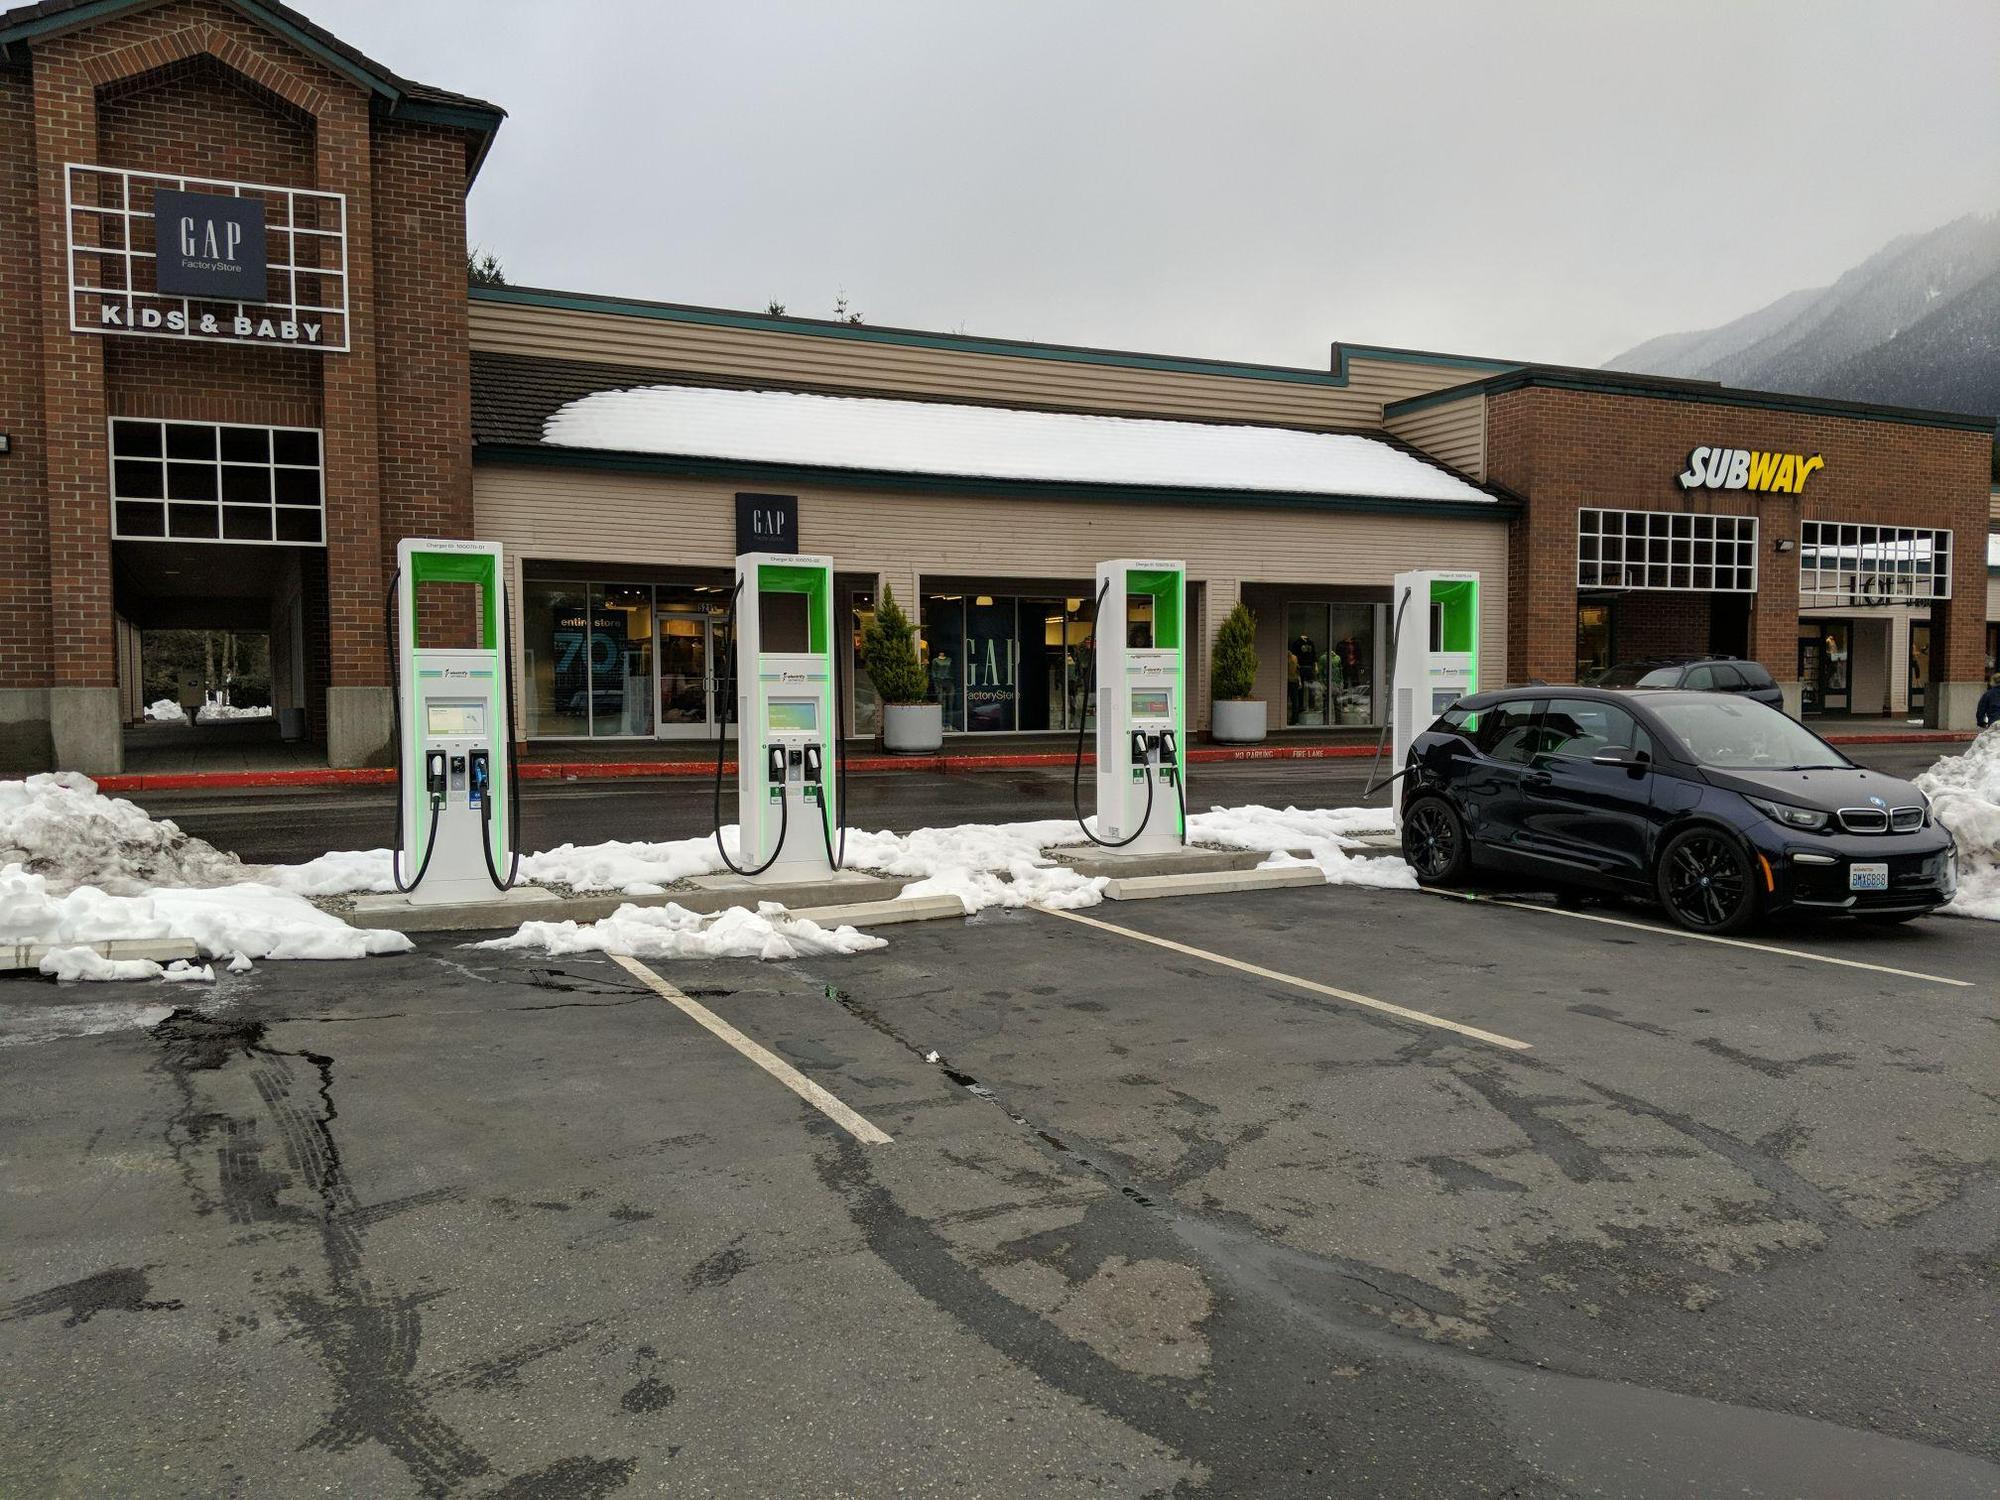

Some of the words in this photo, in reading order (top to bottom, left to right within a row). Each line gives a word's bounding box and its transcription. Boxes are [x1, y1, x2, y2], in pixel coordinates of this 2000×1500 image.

[180, 216, 241, 261] GAP
[101, 304, 186, 331] KIDS
[200, 313, 220, 334] &
[234, 315, 321, 342] BABY
[1680, 446, 1825, 494] SUBWAY
[753, 509, 785, 535] GAP
